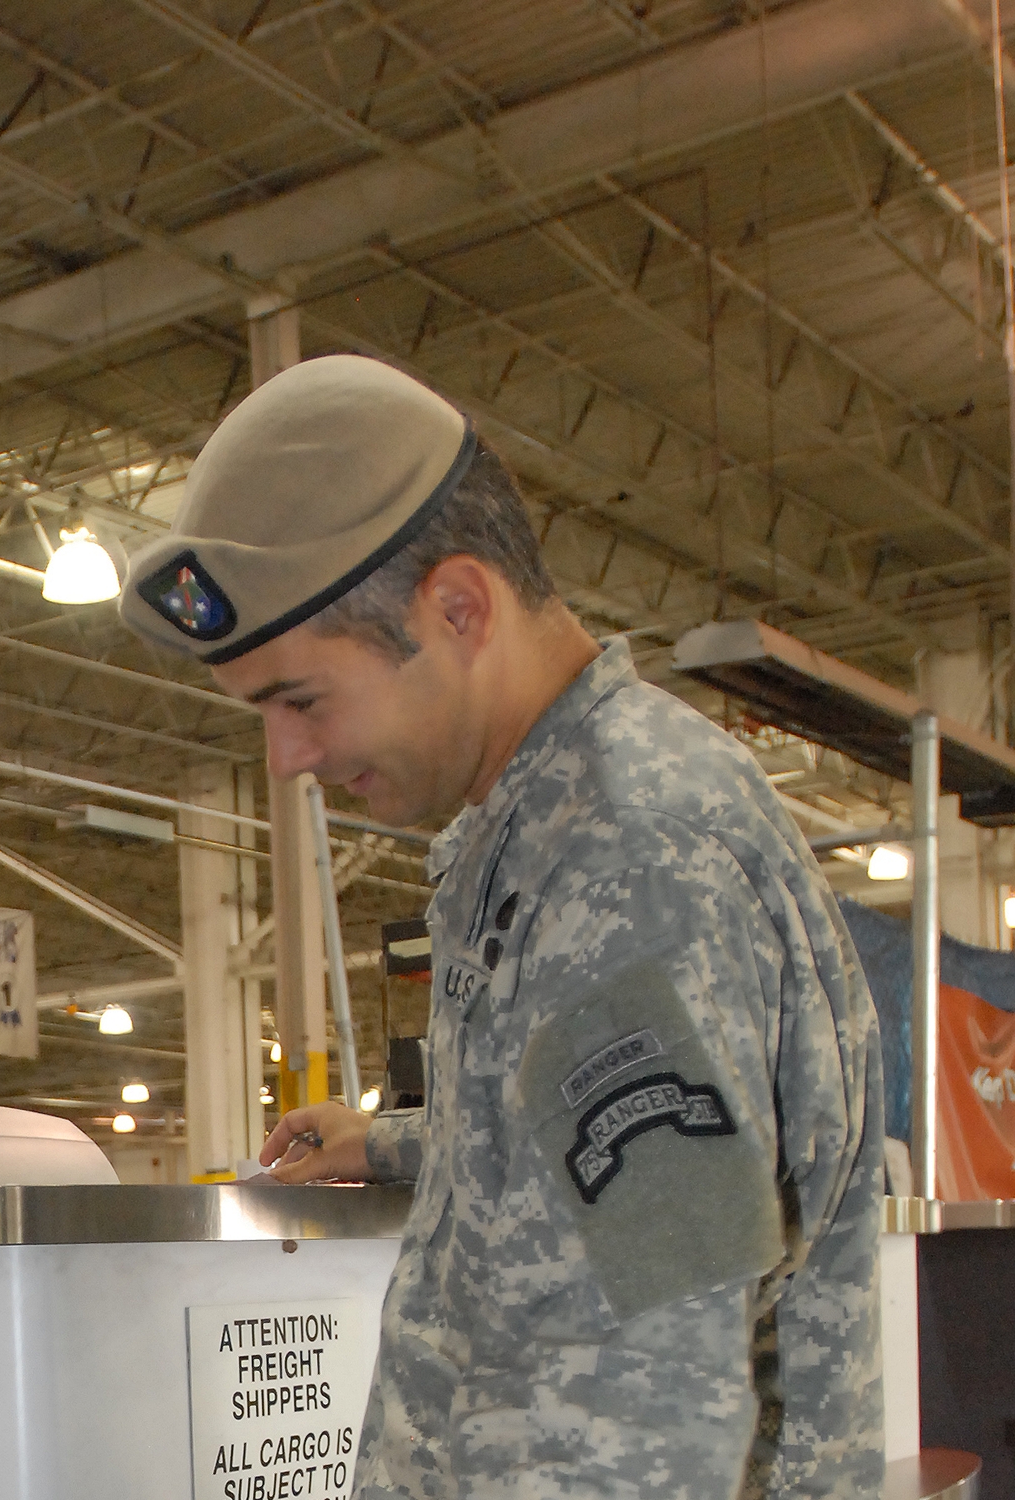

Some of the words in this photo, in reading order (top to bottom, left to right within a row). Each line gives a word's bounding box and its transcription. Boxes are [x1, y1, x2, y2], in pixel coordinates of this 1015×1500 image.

[1, 981, 12, 1007] 1
[569, 1040, 645, 1095] RANGER
[591, 1086, 684, 1146] RANGER
[219, 1313, 339, 1353] ATTENTION:
[238, 1348, 324, 1384] FREIGHT
[232, 1381, 331, 1421] SHIPPERS
[213, 1442, 252, 1475] ALL
[259, 1430, 331, 1468] CARGO
[336, 1426, 353, 1456] IS
[322, 1461, 347, 1491] TO
